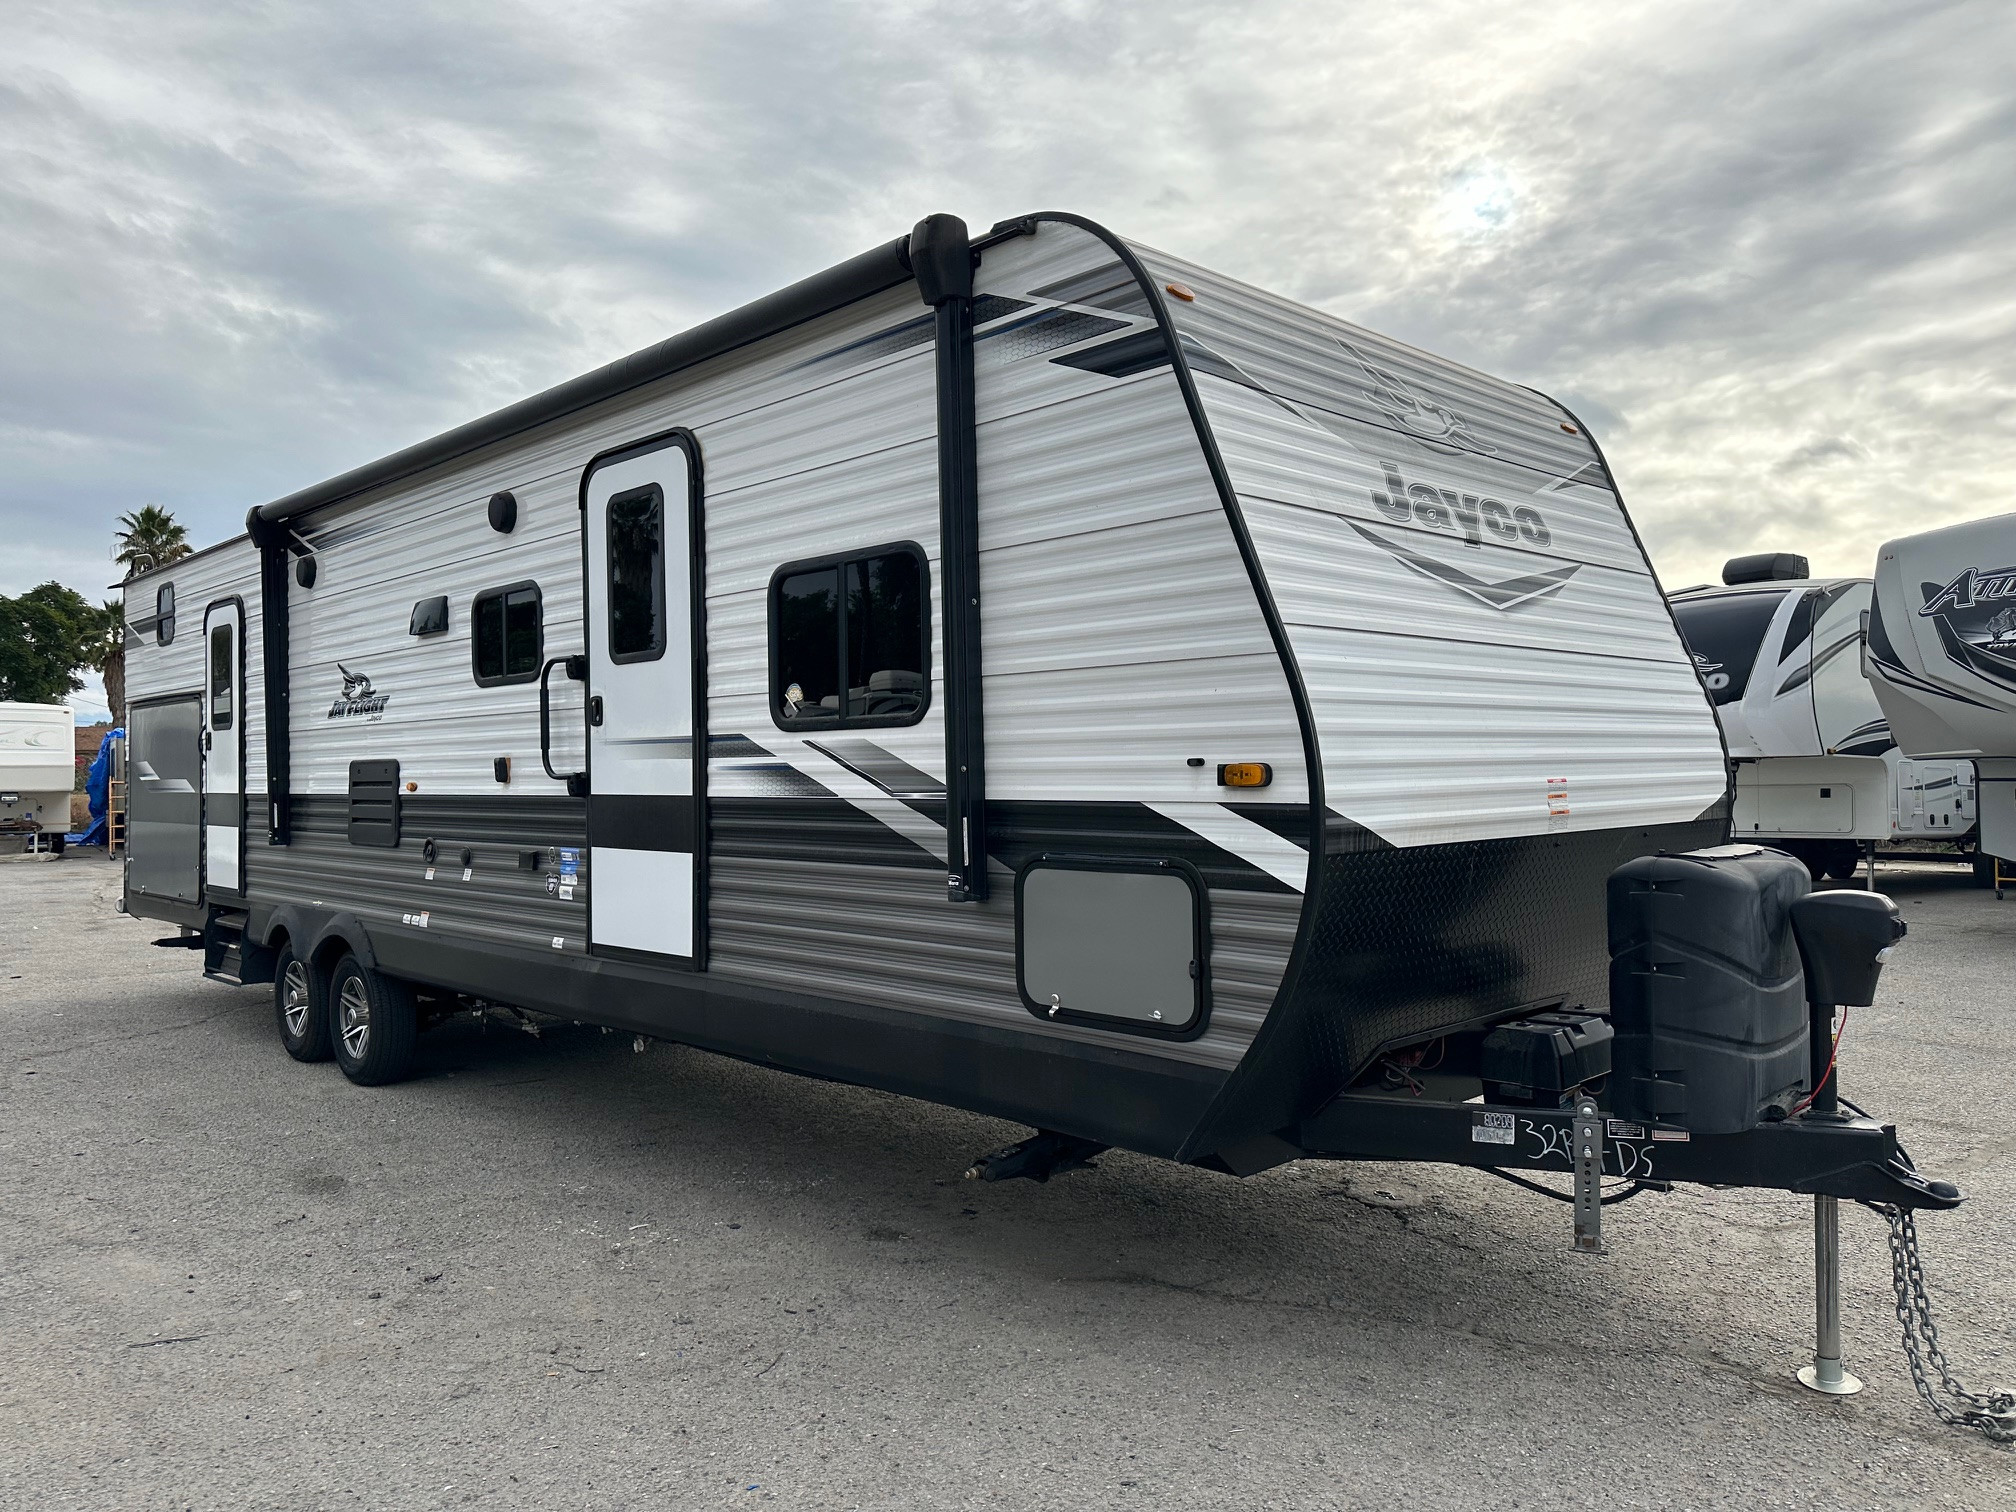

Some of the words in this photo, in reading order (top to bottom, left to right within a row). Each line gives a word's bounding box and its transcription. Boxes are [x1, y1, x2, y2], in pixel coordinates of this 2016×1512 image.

[1370, 460, 1552, 549] Jayco
[327, 700, 349, 719] JAY
[346, 695, 391, 717] FLIGHT
